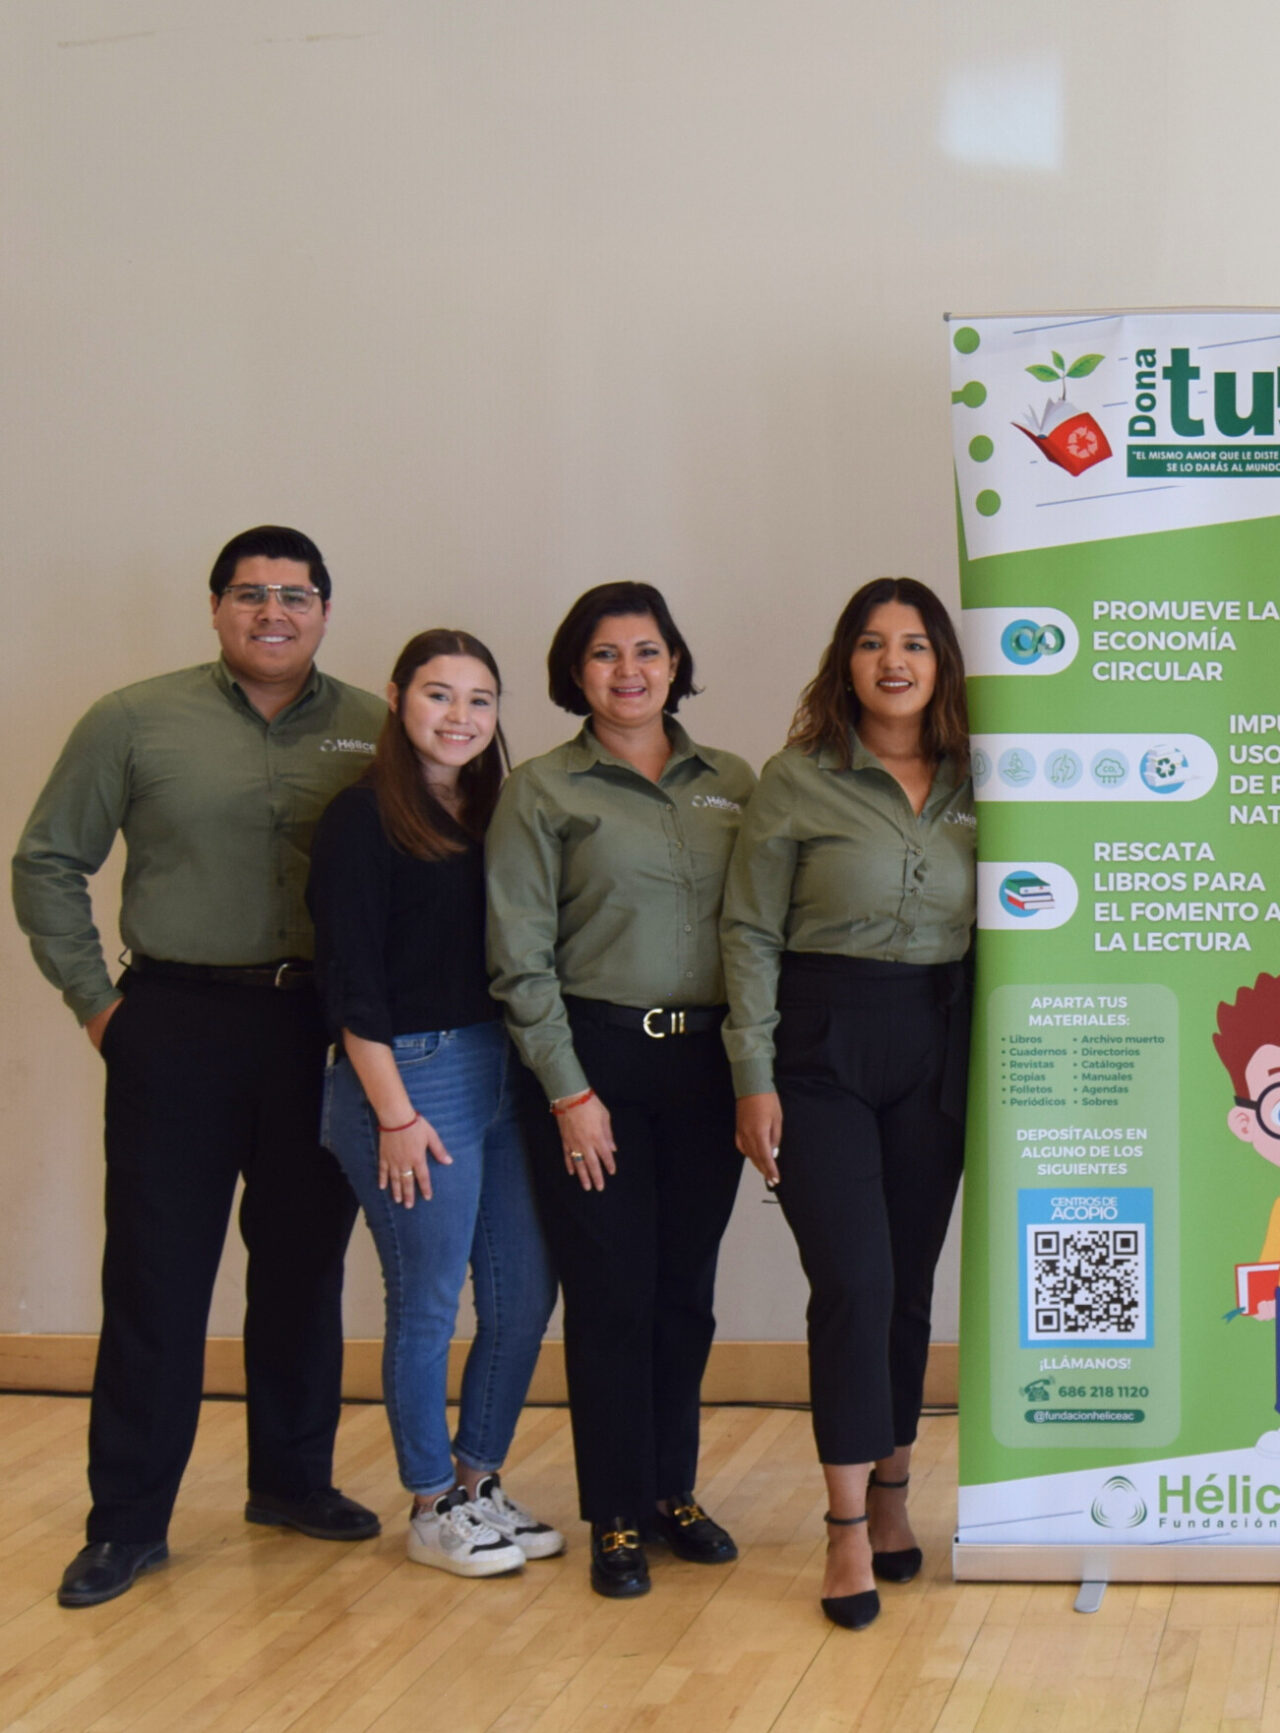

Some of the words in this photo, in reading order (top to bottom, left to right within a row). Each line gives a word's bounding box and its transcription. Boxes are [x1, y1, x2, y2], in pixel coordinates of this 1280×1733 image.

[1128, 347, 1158, 438] Dona
[1163, 347, 1275, 438] tu
[1149, 450, 1184, 461] MISMO
[1186, 450, 1217, 461] AMOR
[1219, 450, 1240, 461] QUE
[1242, 450, 1252, 461] LE
[1254, 450, 1279, 461] DISTE
[1166, 463, 1178, 473] SE
[1180, 463, 1193, 473] LO
[1195, 461, 1229, 473] DARÁS
[1231, 463, 1244, 473] AL
[1093, 600, 1241, 621] PROMUEVE
[1247, 600, 1280, 621] LA
[1093, 626, 1237, 651] ECONOMÍA
[1092, 661, 1223, 681] CIRCULAR
[1230, 775, 1264, 795] DE
[1093, 842, 1216, 862] RESCATA
[1093, 872, 1187, 892] LIBROS
[1193, 872, 1266, 892] PARA
[1093, 902, 1125, 922] EL
[1131, 902, 1258, 922] FOMENTO
[1093, 932, 1127, 952] LA
[1133, 932, 1252, 952] LECTURA
[1030, 996, 1094, 1009] APARTA
[1097, 996, 1128, 1009] TUS
[1028, 1013, 1131, 1027] MATERIALES:
[1009, 1035, 1043, 1044] Libros
[1081, 1035, 1123, 1044] Archivo
[1125, 1036, 1165, 1044] muerto
[1009, 1048, 1068, 1056] Cuadernos
[1081, 1048, 1141, 1056] Directorios
[1009, 1060, 1055, 1069] Revistas
[1081, 1060, 1135, 1071] Catálogos
[1009, 1073, 1046, 1083] Copias
[1081, 1073, 1133, 1082] Manuales
[1009, 1085, 1053, 1094] Folletos
[1081, 1085, 1129, 1096] Agendas
[1010, 1097, 1067, 1107] Periódicos
[1081, 1097, 1119, 1106] Sobres
[1016, 1125, 1123, 1141] DEPOSÍTALOS
[1126, 1128, 1148, 1140] EN
[1021, 1146, 1086, 1158] ALGUNO
[1089, 1146, 1110, 1158] DE
[1114, 1145, 1144, 1157] LOS
[1037, 1163, 1128, 1175] SIGUIENTES
[1050, 1196, 1100, 1207] CENTROS
[1102, 1196, 1118, 1206] DE
[1051, 1206, 1118, 1221] ACOPIO
[1039, 1355, 1132, 1372] ¡LLÁMANOS!
[1058, 1386, 1087, 1398] 686
[1090, 1386, 1114, 1398] 218
[1117, 1386, 1149, 1398] 1120
[1033, 1411, 1135, 1423] @fundacionheliceac
[1158, 1517, 1278, 1528] Fundación
